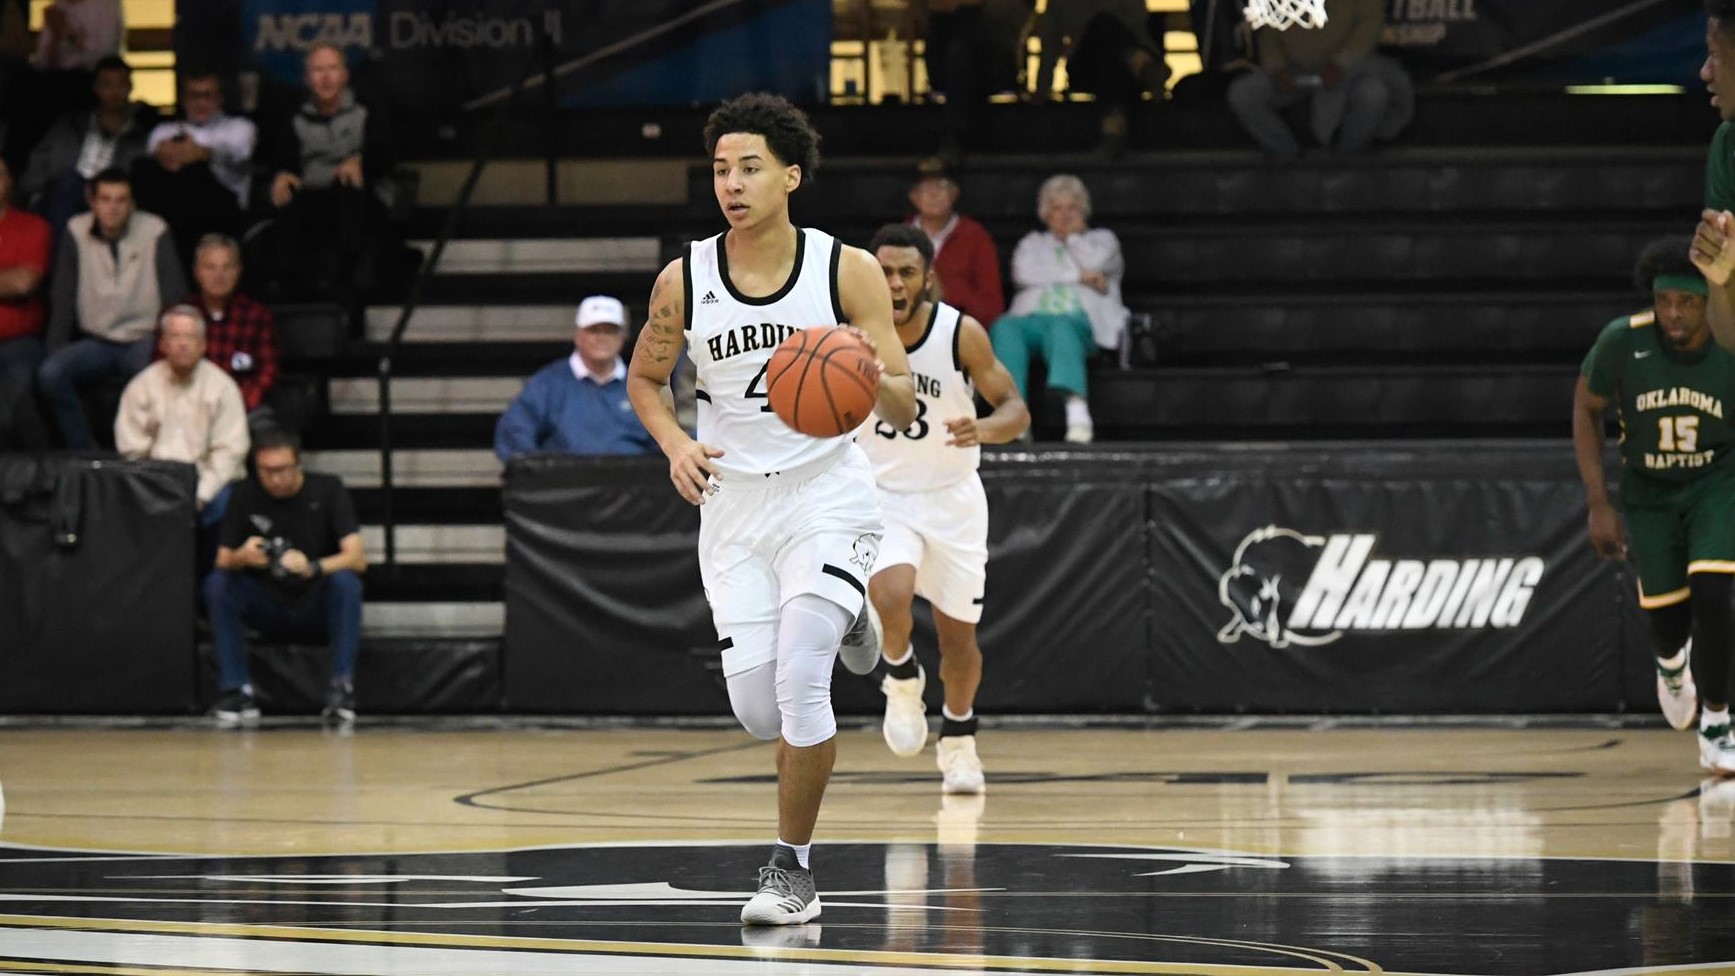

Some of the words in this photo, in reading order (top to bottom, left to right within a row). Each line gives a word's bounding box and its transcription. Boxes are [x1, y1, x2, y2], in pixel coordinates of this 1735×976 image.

[254, 12, 373, 51] NCAA
[389, 9, 534, 49] Division
[707, 322, 805, 361] HARDI
[1636, 387, 1724, 419] OKLAHOMA
[1658, 415, 1700, 452] 15
[1644, 450, 1714, 469] BAPTIST
[1287, 533, 1545, 630] HARDING
